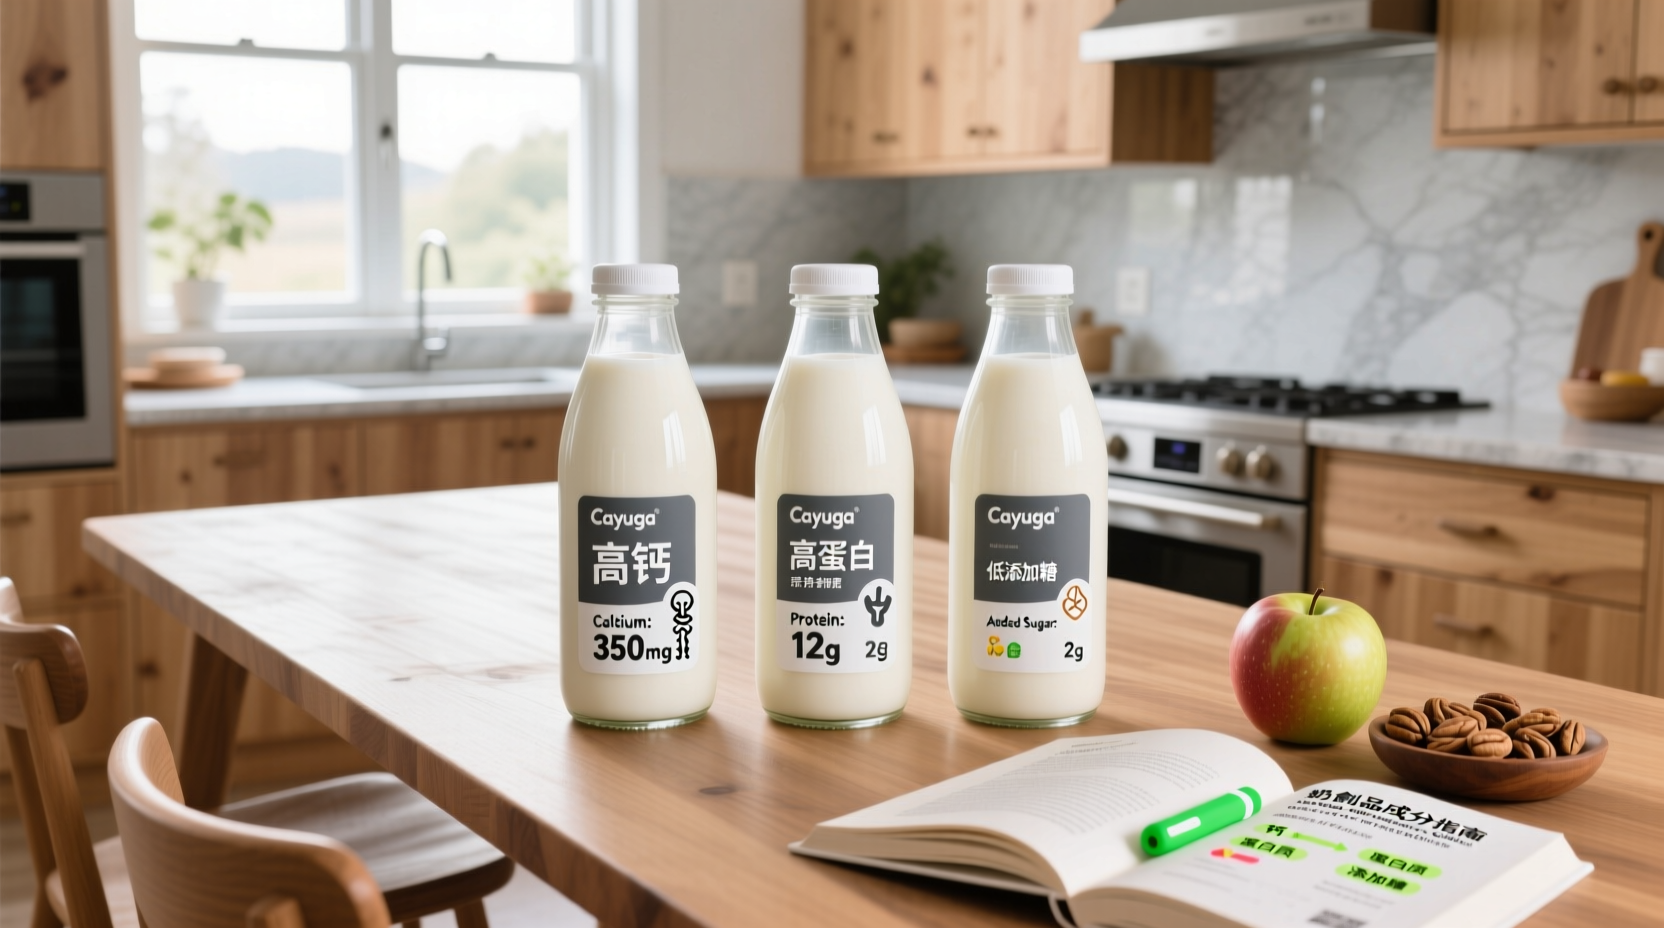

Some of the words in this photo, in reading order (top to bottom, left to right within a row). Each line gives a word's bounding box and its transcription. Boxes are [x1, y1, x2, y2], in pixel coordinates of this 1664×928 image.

[592, 541, 672, 585] 高钙
[789, 539, 874, 571] 高蛋白
[790, 612, 845, 627] Protein:
[791, 631, 841, 666] 12g
[1064, 641, 1084, 662] 2g
